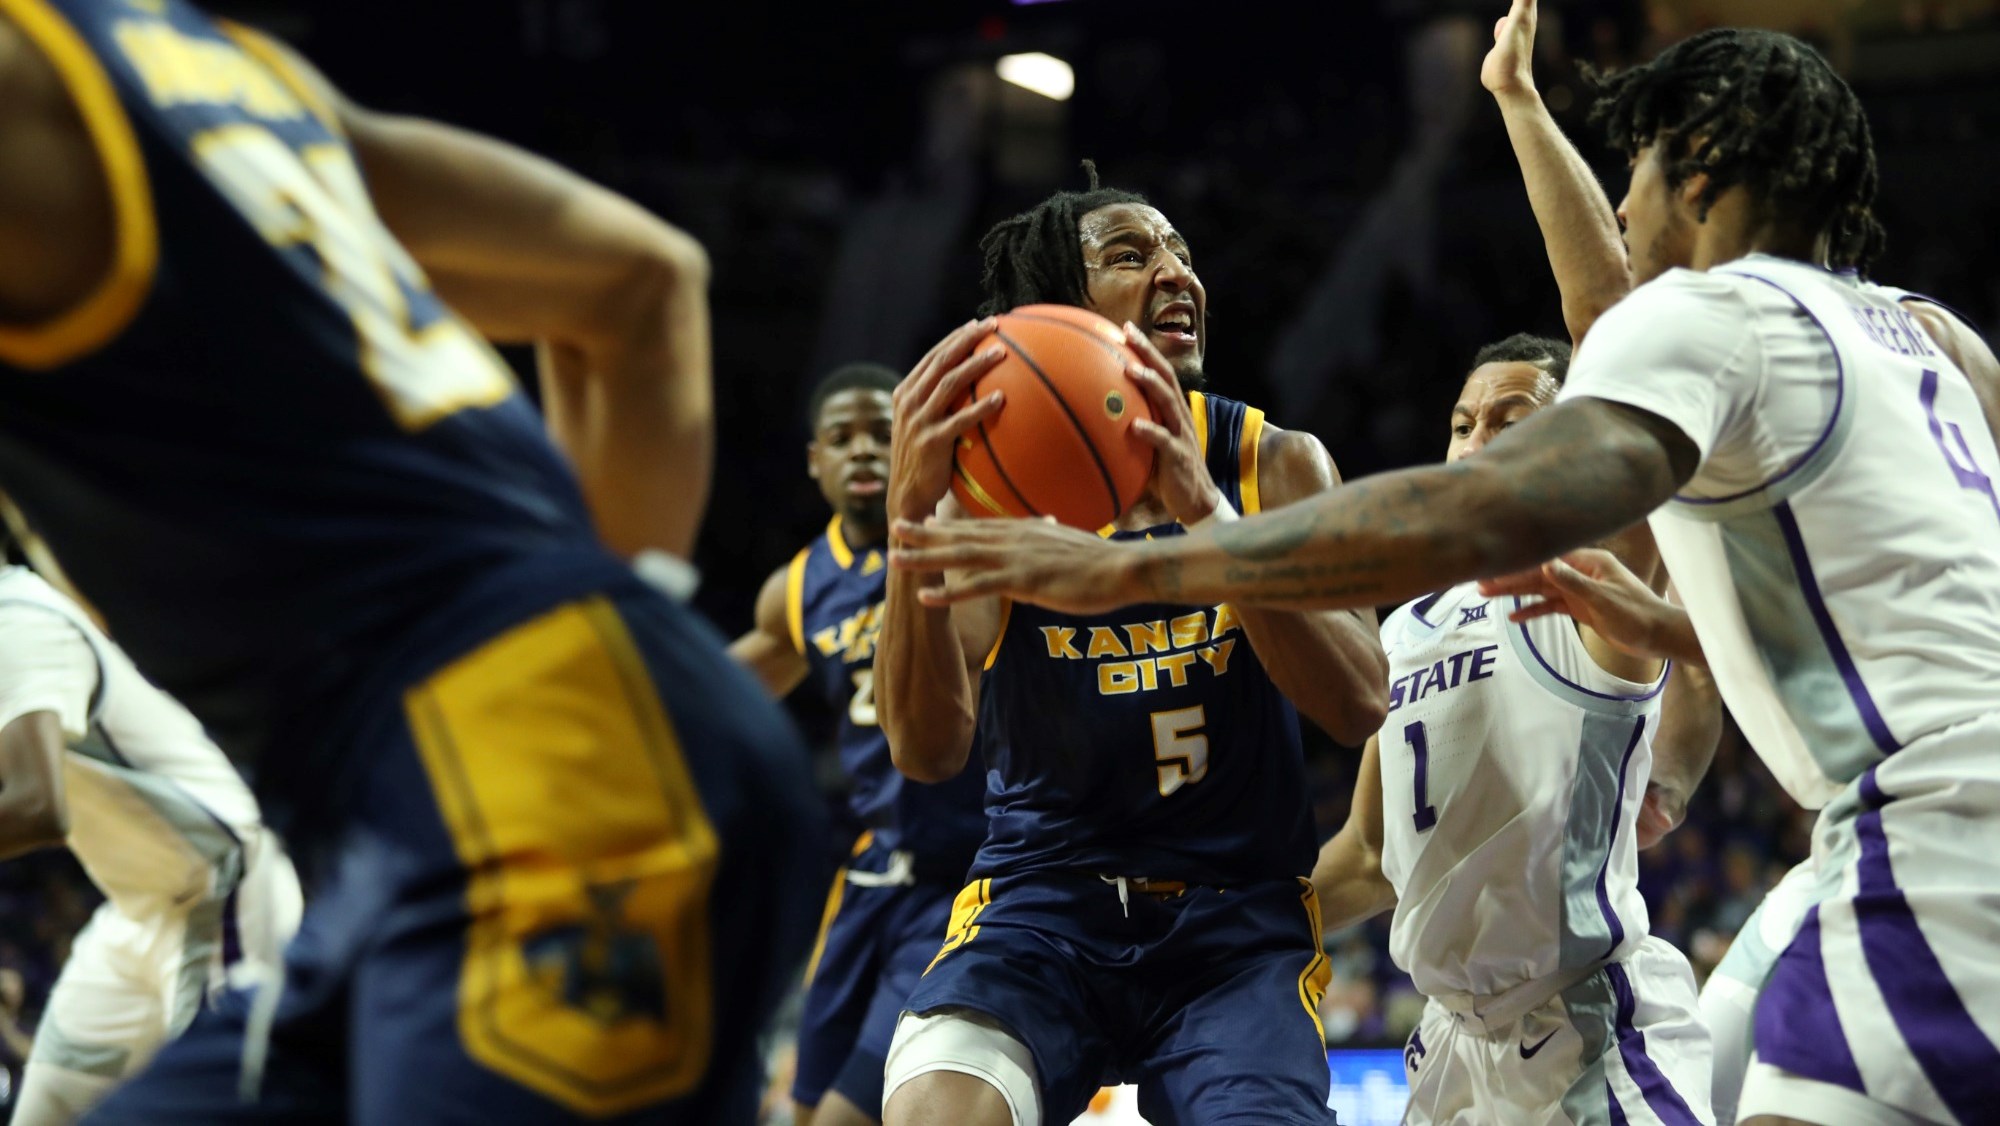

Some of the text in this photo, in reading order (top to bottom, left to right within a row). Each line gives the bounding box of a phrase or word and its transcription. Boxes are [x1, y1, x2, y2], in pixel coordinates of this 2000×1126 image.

[1918, 368, 2000, 528] 4
[1038, 602, 1242, 660] KANSA
[1097, 638, 1236, 695] CITY
[1150, 703, 1209, 797] 5
[1404, 720, 1438, 834] 1
